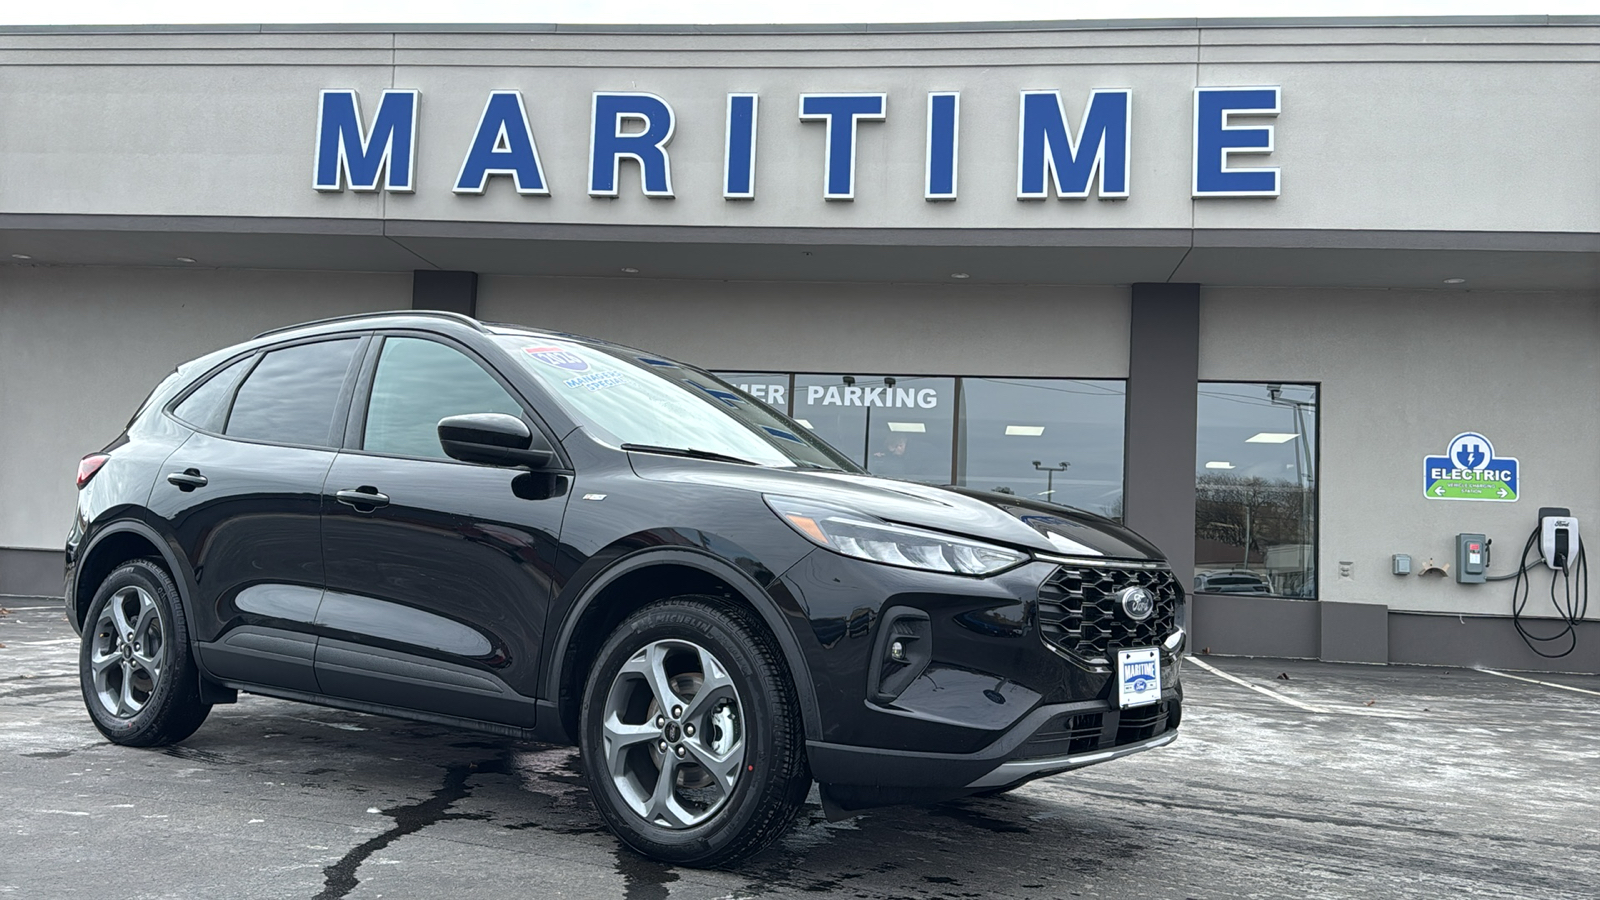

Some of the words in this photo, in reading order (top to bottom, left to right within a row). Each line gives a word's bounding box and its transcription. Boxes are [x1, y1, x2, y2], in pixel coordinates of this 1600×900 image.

[312, 86, 1281, 200] MARITIME
[807, 385, 938, 409] PARKING
[1431, 468, 1512, 481] ELECTRIC
[655, 614, 711, 632] MICHELIN
[1124, 662, 1156, 682] MARITIME
